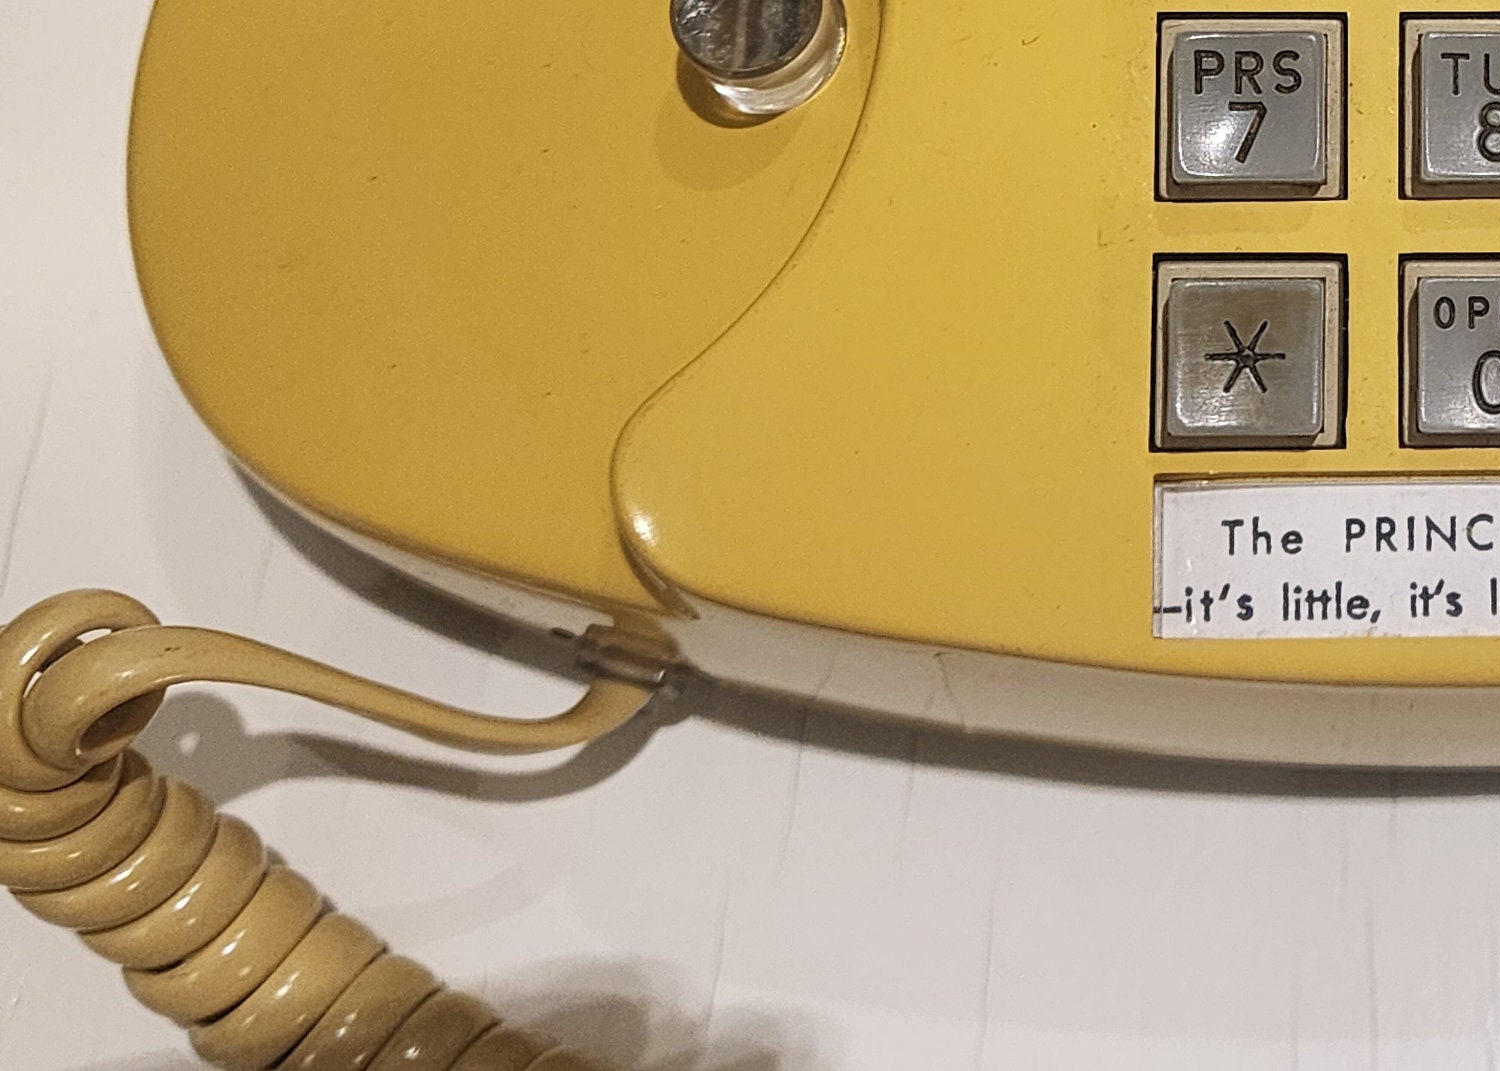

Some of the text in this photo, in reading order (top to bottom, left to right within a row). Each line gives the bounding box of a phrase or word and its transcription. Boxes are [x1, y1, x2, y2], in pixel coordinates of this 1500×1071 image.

[1193, 49, 1303, 95] PRS
[1228, 101, 1268, 164] 7
[1221, 516, 1303, 556] The
[1282, 581, 1382, 624] little,
[1409, 579, 1463, 618] it's
